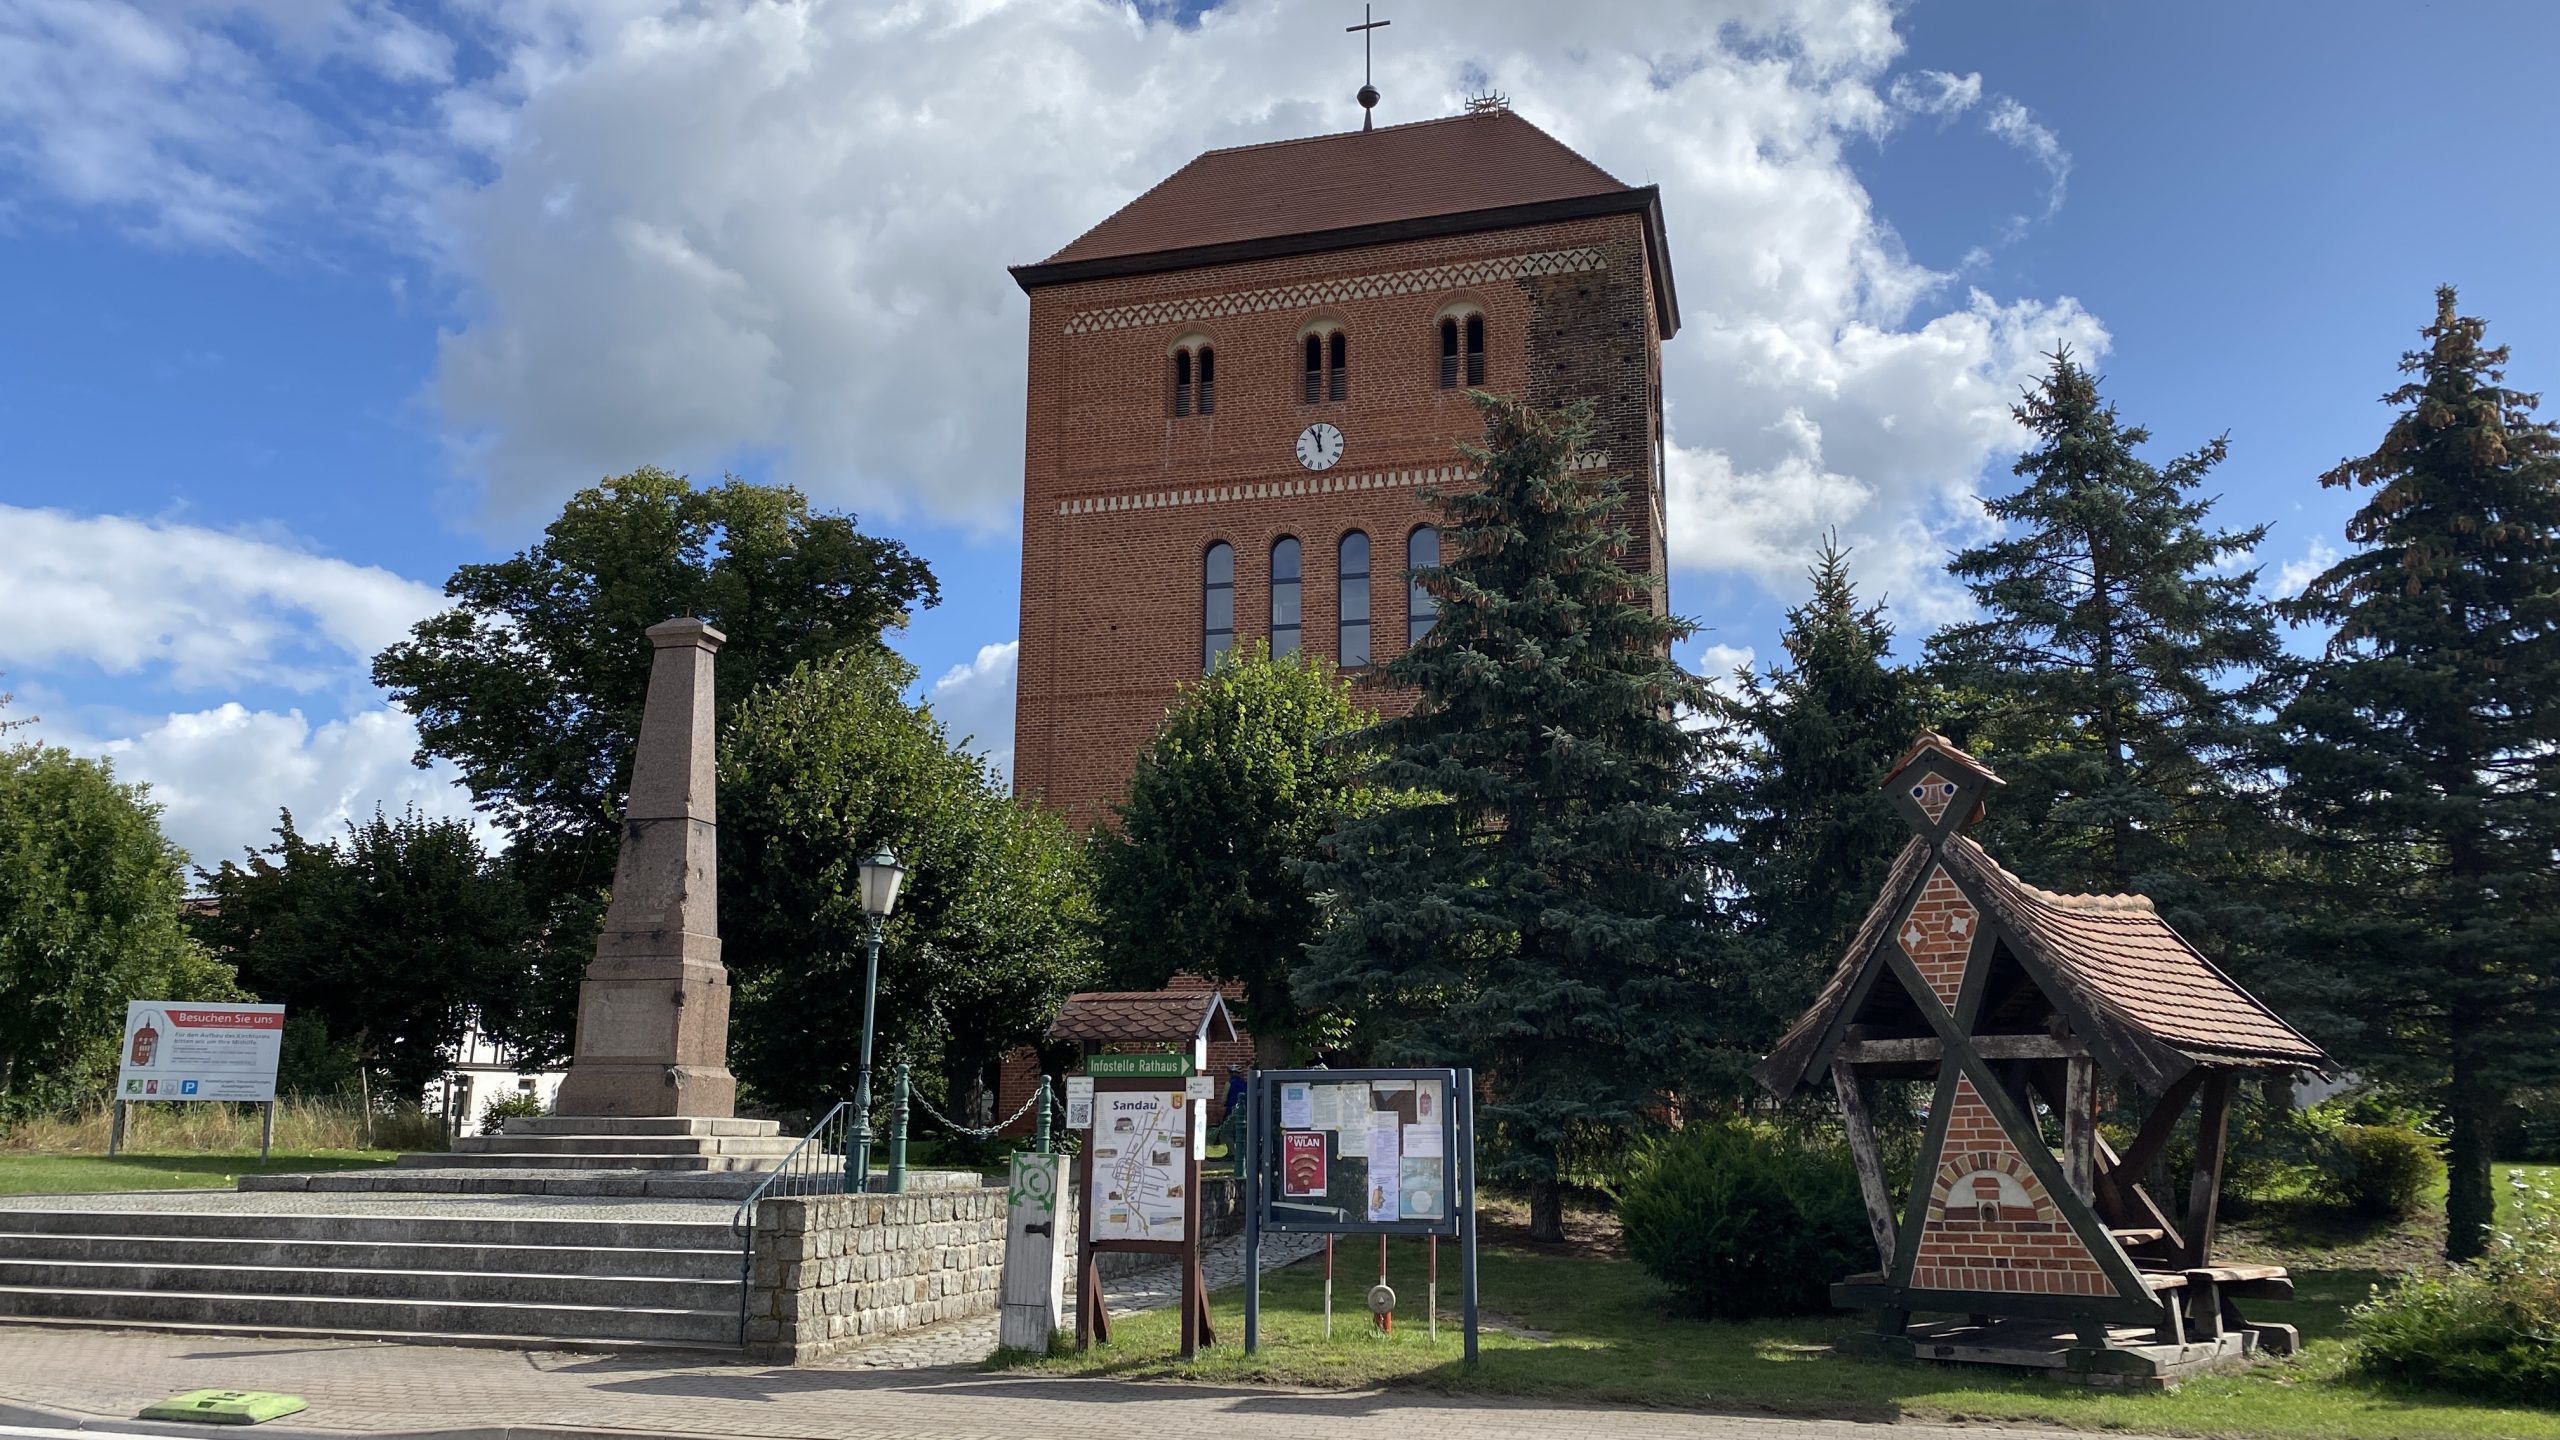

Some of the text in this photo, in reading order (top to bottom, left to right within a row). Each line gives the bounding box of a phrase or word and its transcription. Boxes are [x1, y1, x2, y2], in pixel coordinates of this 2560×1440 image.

[179, 1012, 273, 1024] Besuchen Sie uns
[1091, 1059, 1178, 1072] Infostelle Rathaus
[186, 1082, 195, 1092] P
[1113, 1100, 1157, 1110] Sandau
[1293, 1138, 1320, 1147] WLAN
